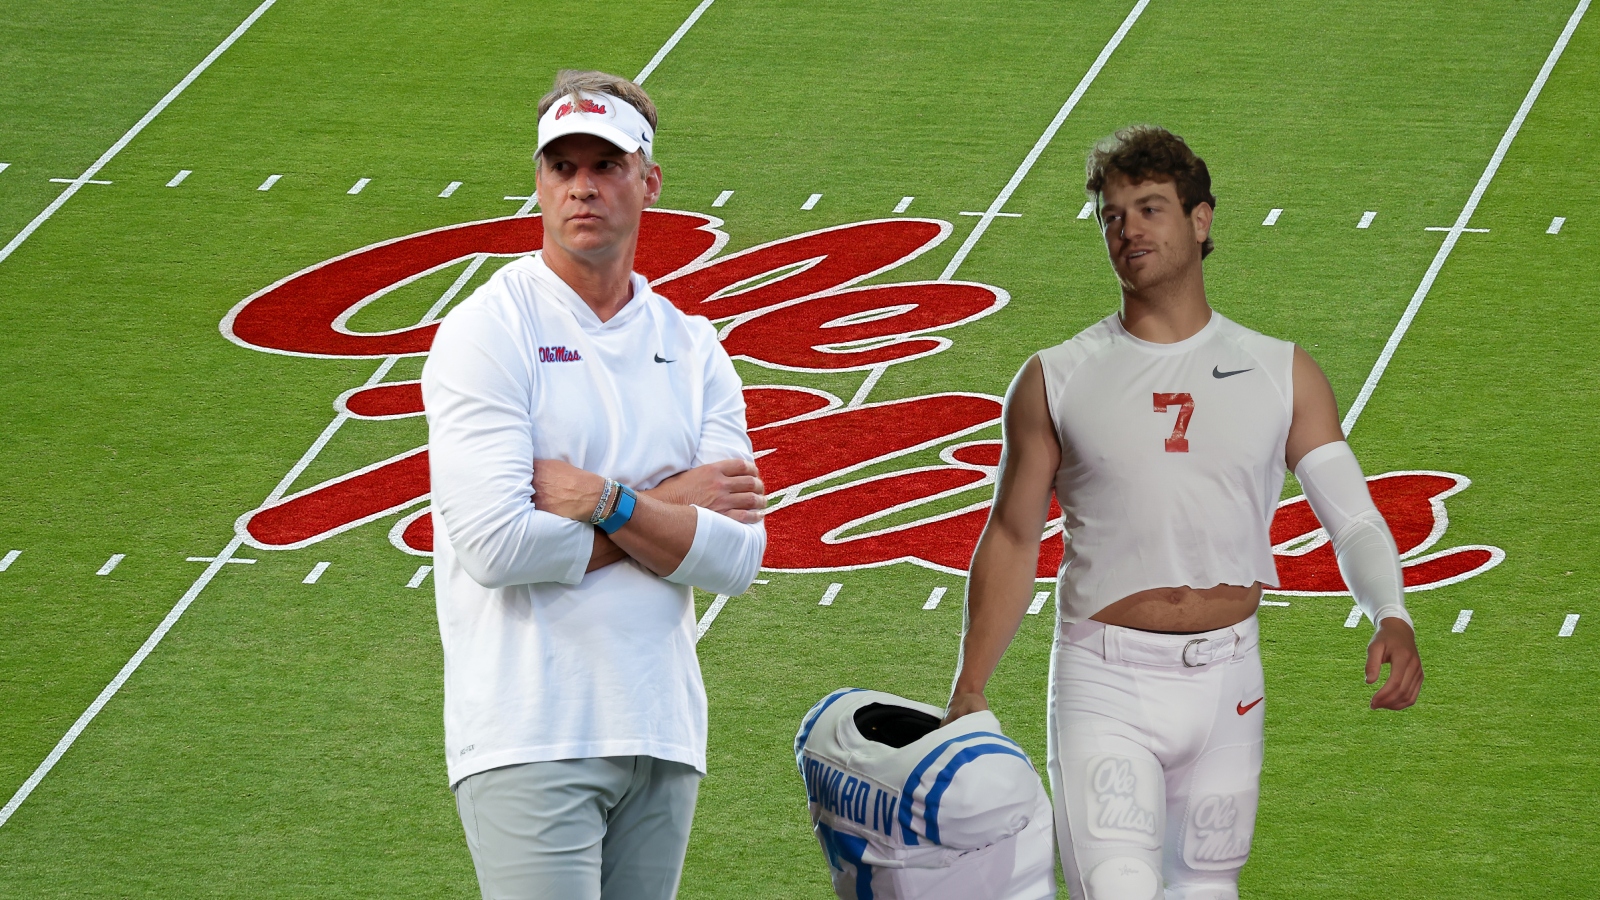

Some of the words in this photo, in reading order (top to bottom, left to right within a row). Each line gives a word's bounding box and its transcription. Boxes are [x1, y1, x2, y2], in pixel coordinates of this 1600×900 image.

[219, 208, 1010, 372] Ole
[551, 346, 581, 362] Miss
[1153, 392, 1195, 453] 7
[1093, 756, 1136, 795] Ole
[873, 788, 898, 837] IV
[1097, 793, 1156, 836] Miss
[1194, 794, 1237, 830] Ole
[1195, 828, 1251, 862] Miss
